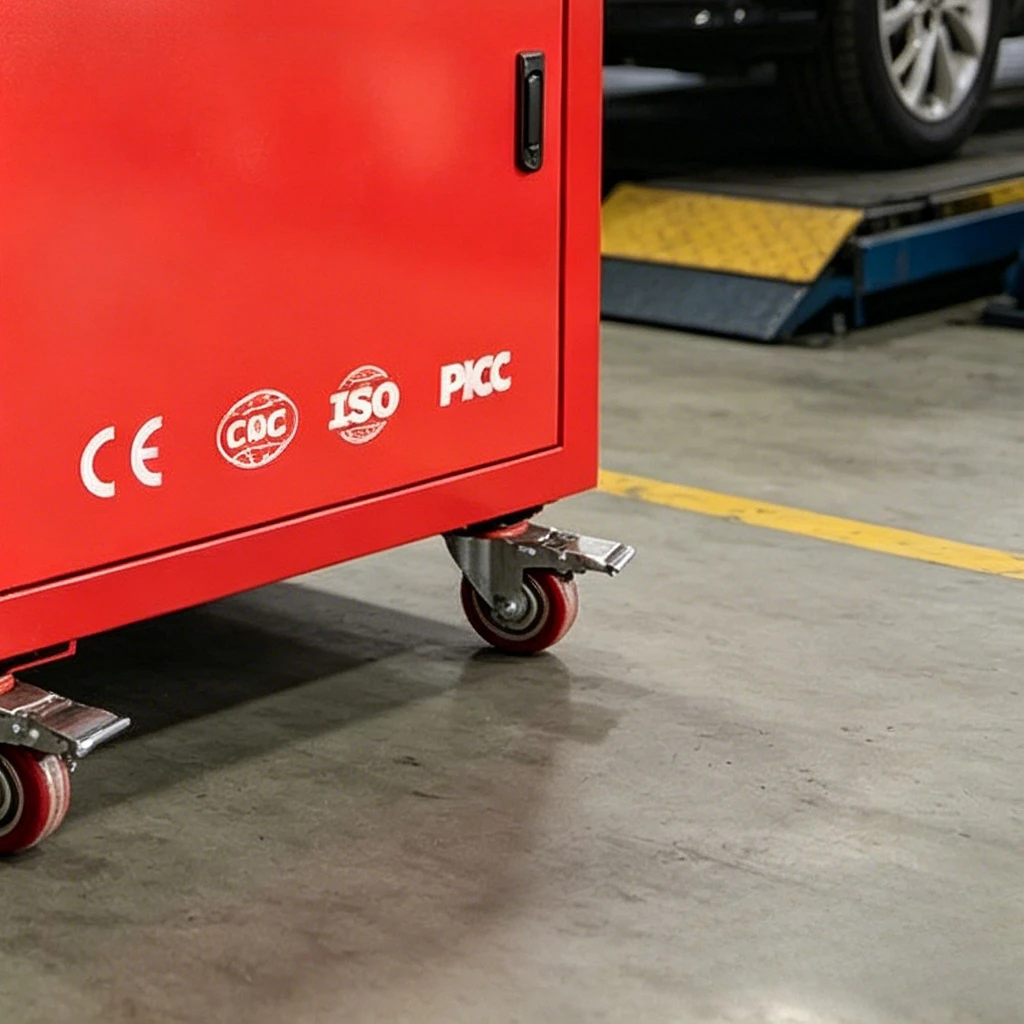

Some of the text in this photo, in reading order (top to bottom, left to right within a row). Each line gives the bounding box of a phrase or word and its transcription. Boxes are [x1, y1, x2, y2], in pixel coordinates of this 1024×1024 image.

[328, 381, 401, 431] ISO
[440, 350, 512, 407] PICC
[79, 415, 164, 499] CE
